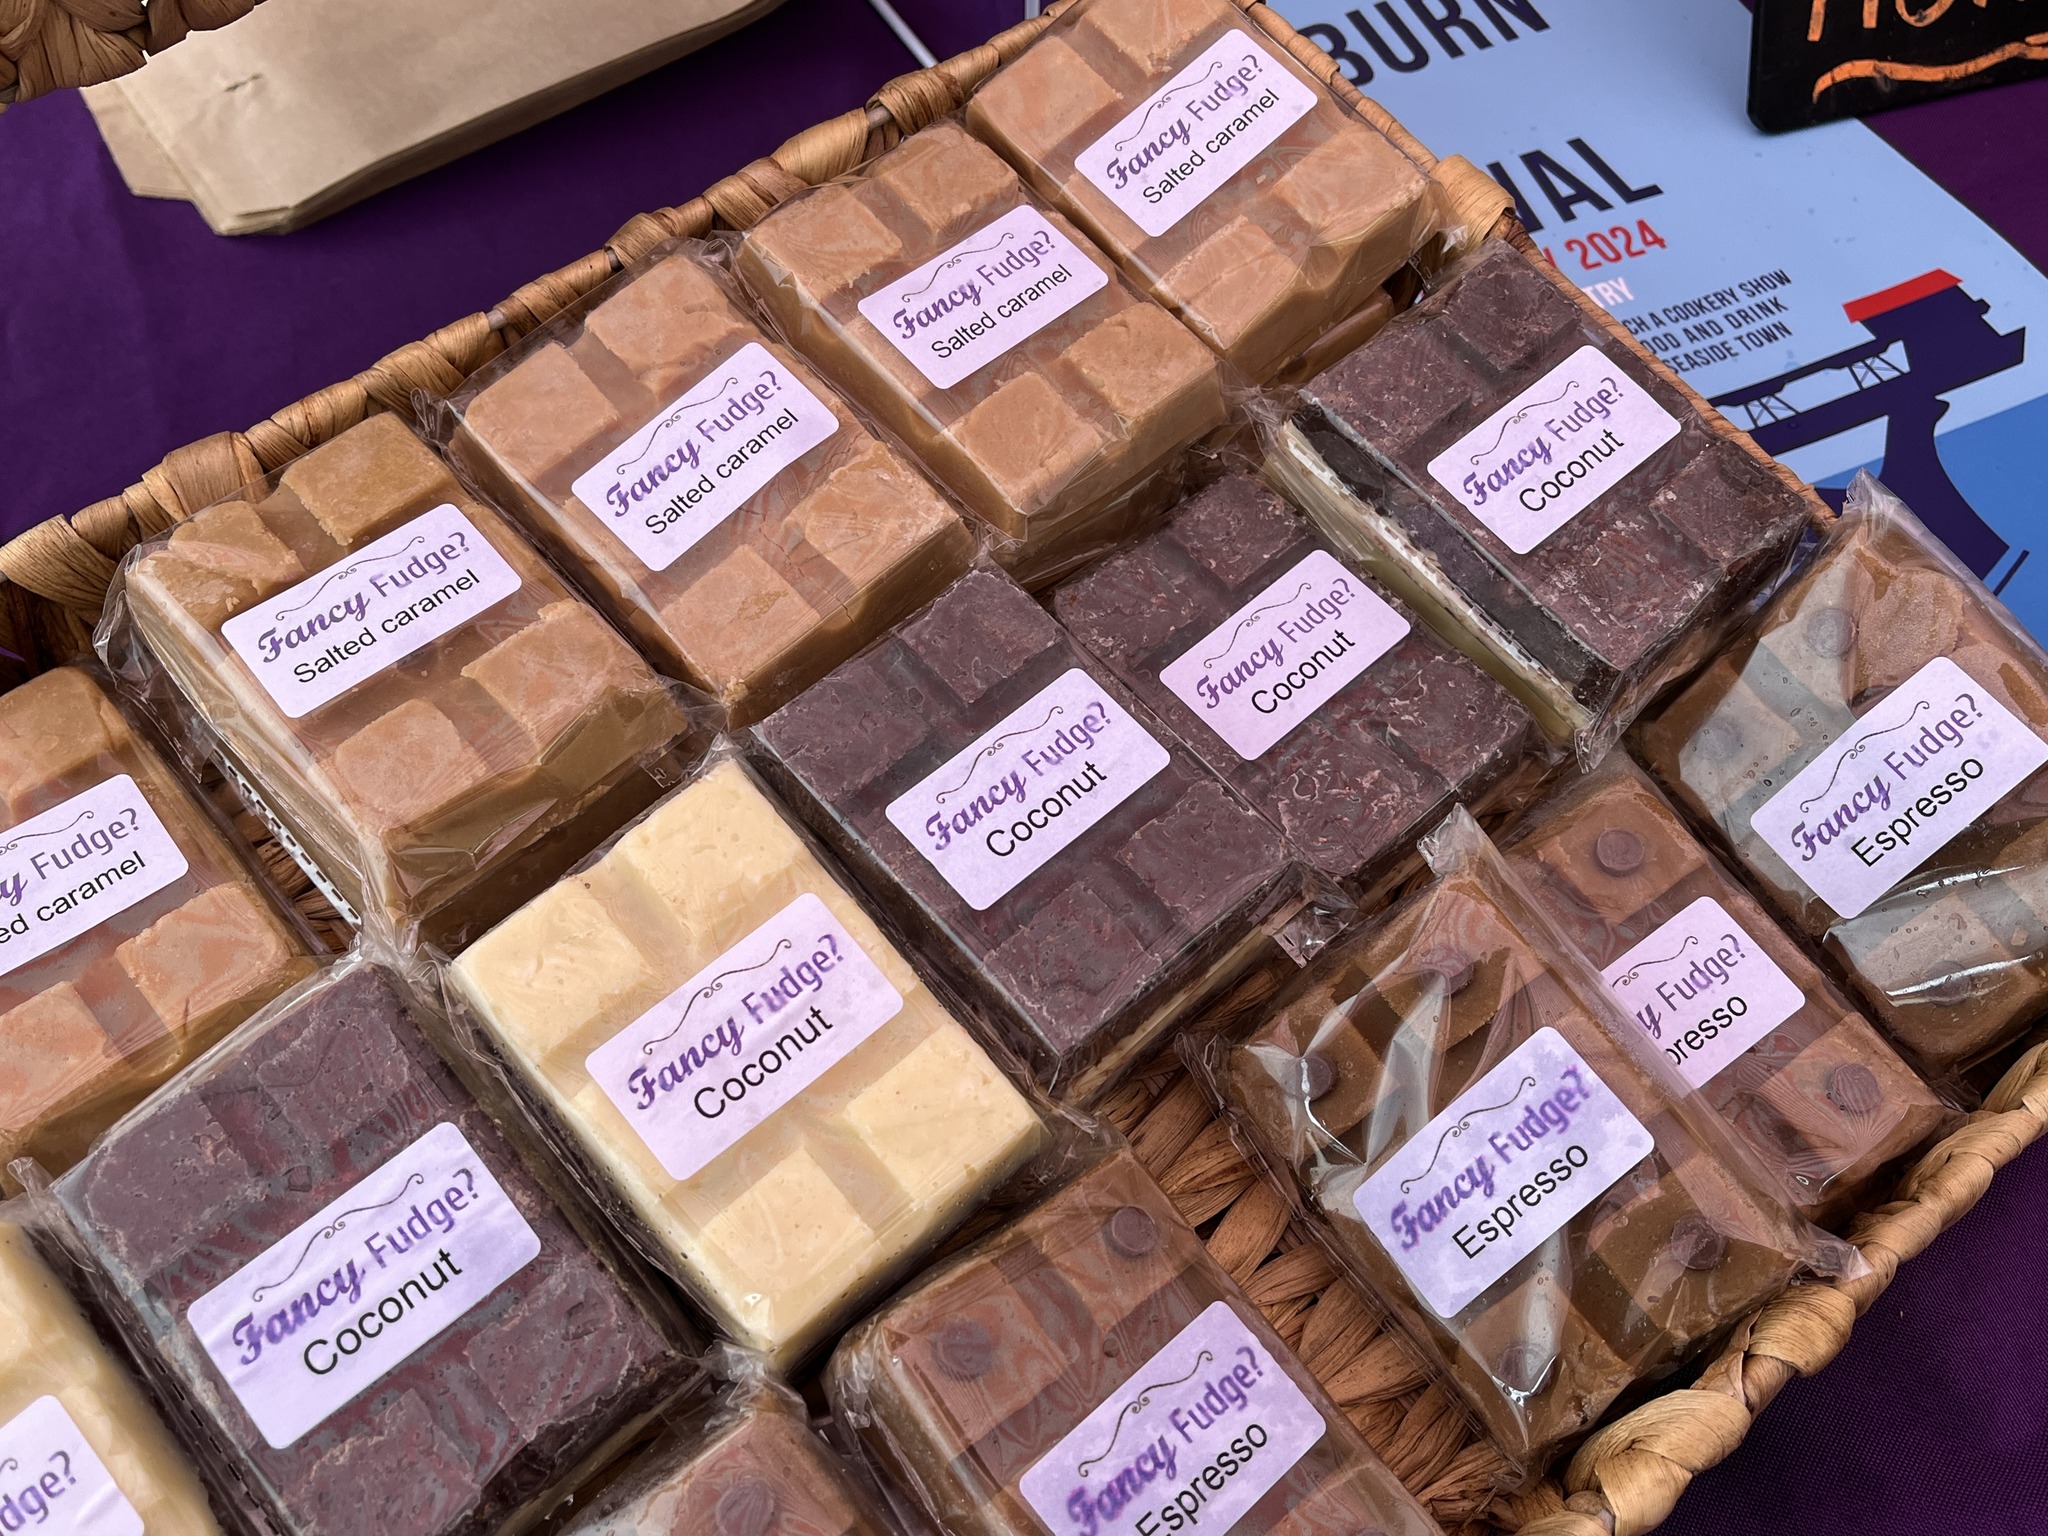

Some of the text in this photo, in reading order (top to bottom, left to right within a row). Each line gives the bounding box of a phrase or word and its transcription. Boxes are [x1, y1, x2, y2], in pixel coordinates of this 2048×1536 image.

[1106, 54, 1263, 190] Fancy Fudge?
[1142, 88, 1280, 204] Salted caramel
[893, 230, 1056, 339] Fancy Fudge?
[1564, 218, 1667, 271] 2024
[1648, 312, 1667, 329] A
[1662, 287, 1740, 323] COOKERY
[1738, 269, 1792, 298] SHOW
[931, 263, 1073, 359] Salted caramel
[1662, 321, 1793, 374] SEASIDE TOWN
[1682, 319, 1724, 344] AND
[1723, 296, 1788, 329] DRINK
[605, 370, 782, 518] Fancy Fudge?
[645, 407, 799, 535] Salted caramel
[1463, 376, 1624, 506] Fancy Fudge?
[1518, 428, 1625, 512] Coconut
[258, 531, 470, 664] Fancy Fudge?
[293, 568, 481, 683] Salted caramel
[1196, 577, 1355, 709] Fancy Fudge?
[1251, 629, 1356, 714] Coconut
[925, 701, 1111, 851] Fancy Fudge?
[986, 761, 1107, 857] Coconut
[1791, 693, 1983, 862] Fancy Fudge?
[1850, 758, 1984, 868] Espresso
[29, 807, 140, 880] Fudge?
[36, 850, 146, 922] caramel
[628, 933, 844, 1110] Fancy Fudge?
[1655, 934, 1746, 1011] Fudge?
[694, 1005, 833, 1119] Coconut
[1390, 1064, 1591, 1252] Fancy Fudge?
[1451, 1144, 1588, 1260] Espresso
[232, 1168, 479, 1366] Fancy Fudge?
[303, 1248, 463, 1375] Coconut
[1066, 1346, 1264, 1536] Fancy Fudge?
[1135, 1423, 1268, 1536] Espresso
